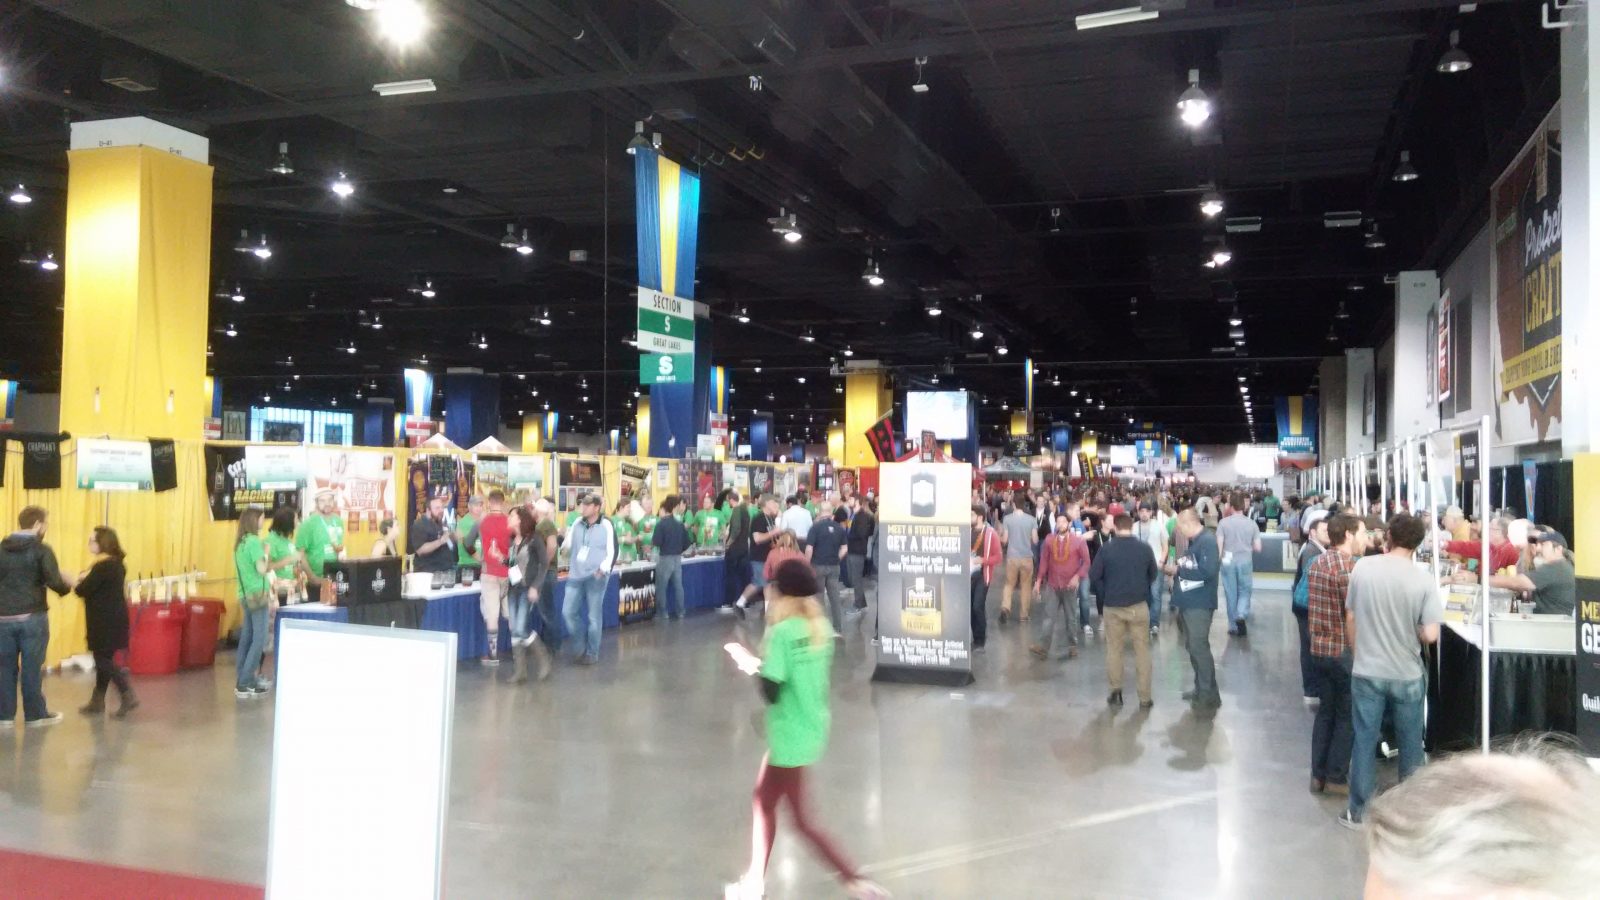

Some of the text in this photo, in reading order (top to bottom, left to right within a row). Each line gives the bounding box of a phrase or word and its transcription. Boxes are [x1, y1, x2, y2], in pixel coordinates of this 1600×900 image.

[653, 294, 682, 314] SECTION
[664, 315, 671, 333] S
[653, 336, 681, 351] GREAT LAKES
[658, 355, 674, 376] S
[887, 524, 907, 535] MEET
[914, 525, 934, 536] STATE
[887, 535, 960, 553] GET A KOOZIE!
[901, 554, 910, 564] Get
[910, 554, 930, 565] Started
[908, 597, 933, 608] CRAFT
[906, 620, 934, 631] PASSPORT
